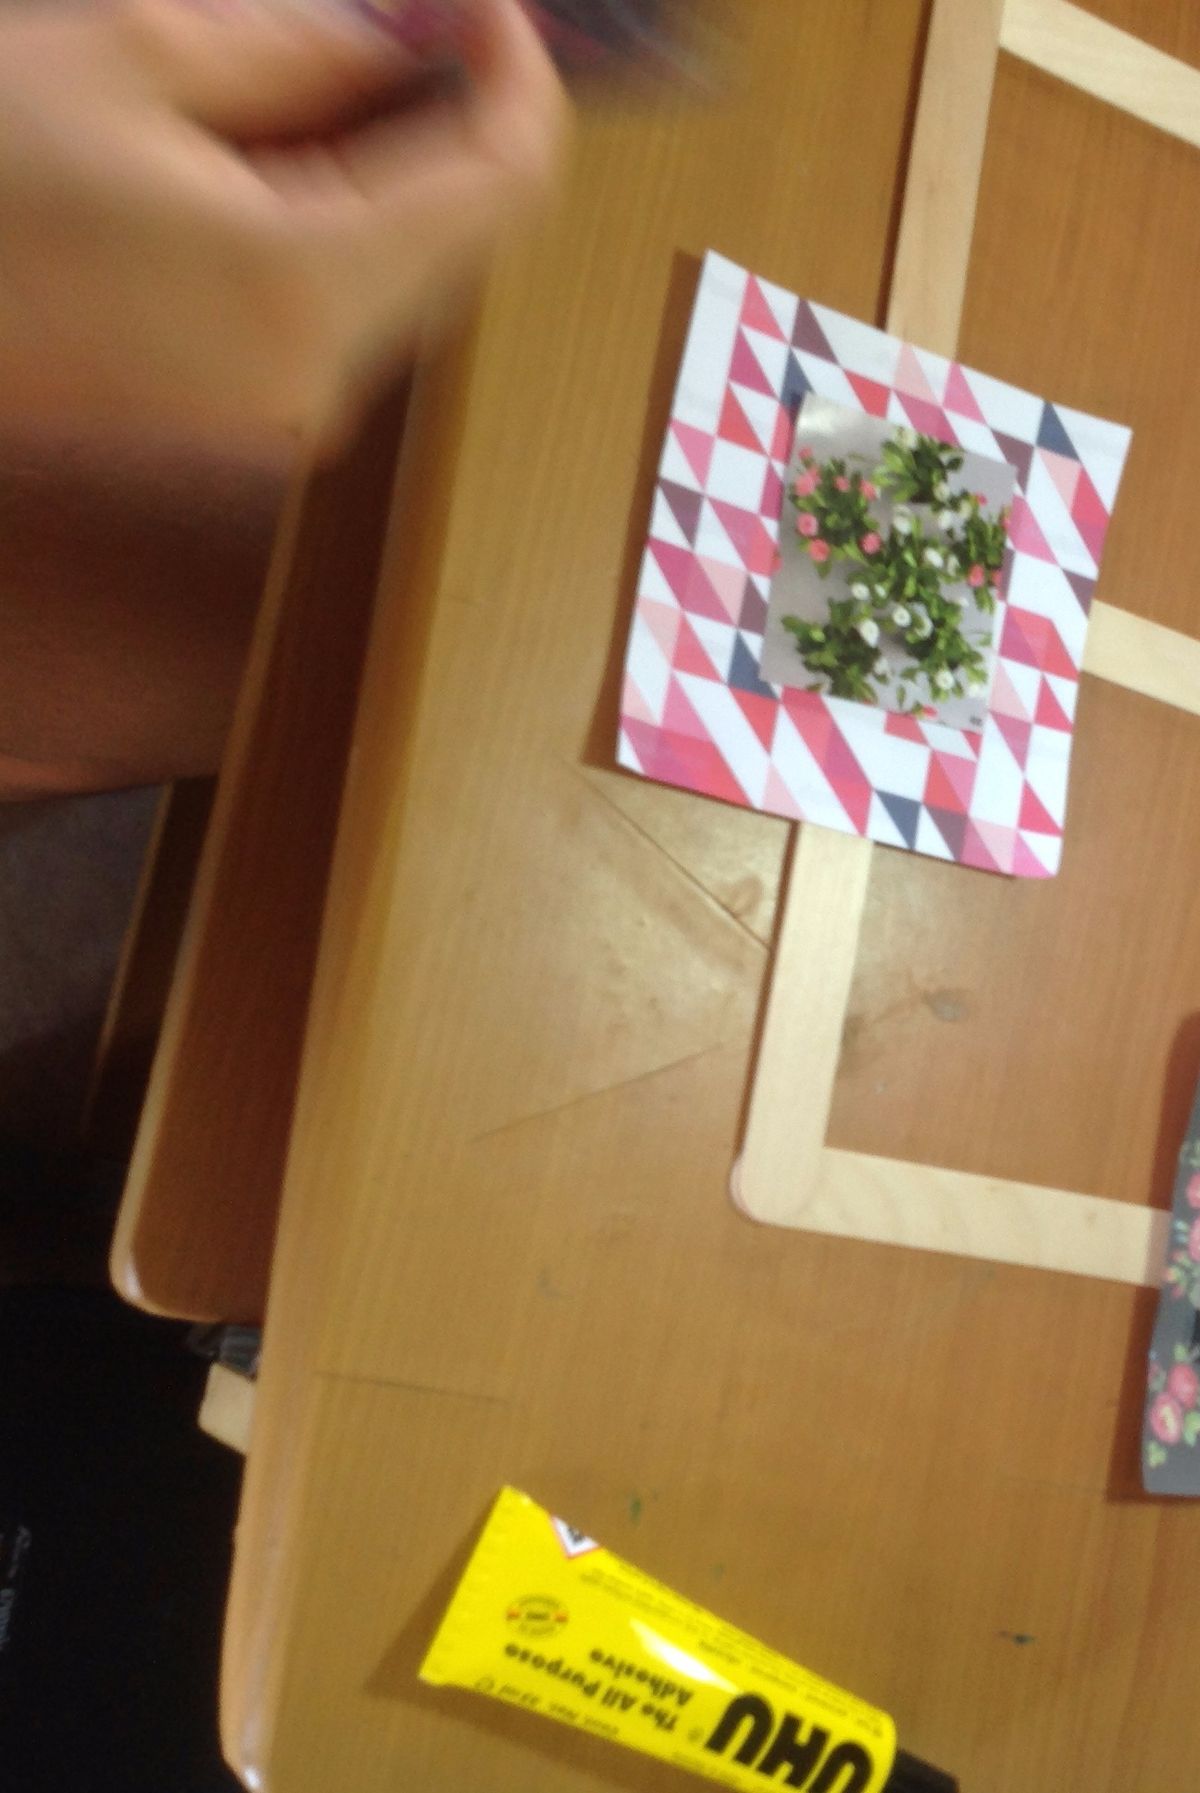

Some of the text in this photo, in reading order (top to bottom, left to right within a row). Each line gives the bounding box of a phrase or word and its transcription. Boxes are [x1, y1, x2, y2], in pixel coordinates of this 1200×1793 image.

[504, 1643, 600, 1698] Purpose
[590, 1648, 694, 1704] Adhesive
[601, 1687, 637, 1714] All
[641, 1702, 680, 1732] The
[705, 1691, 874, 1793] UHU
